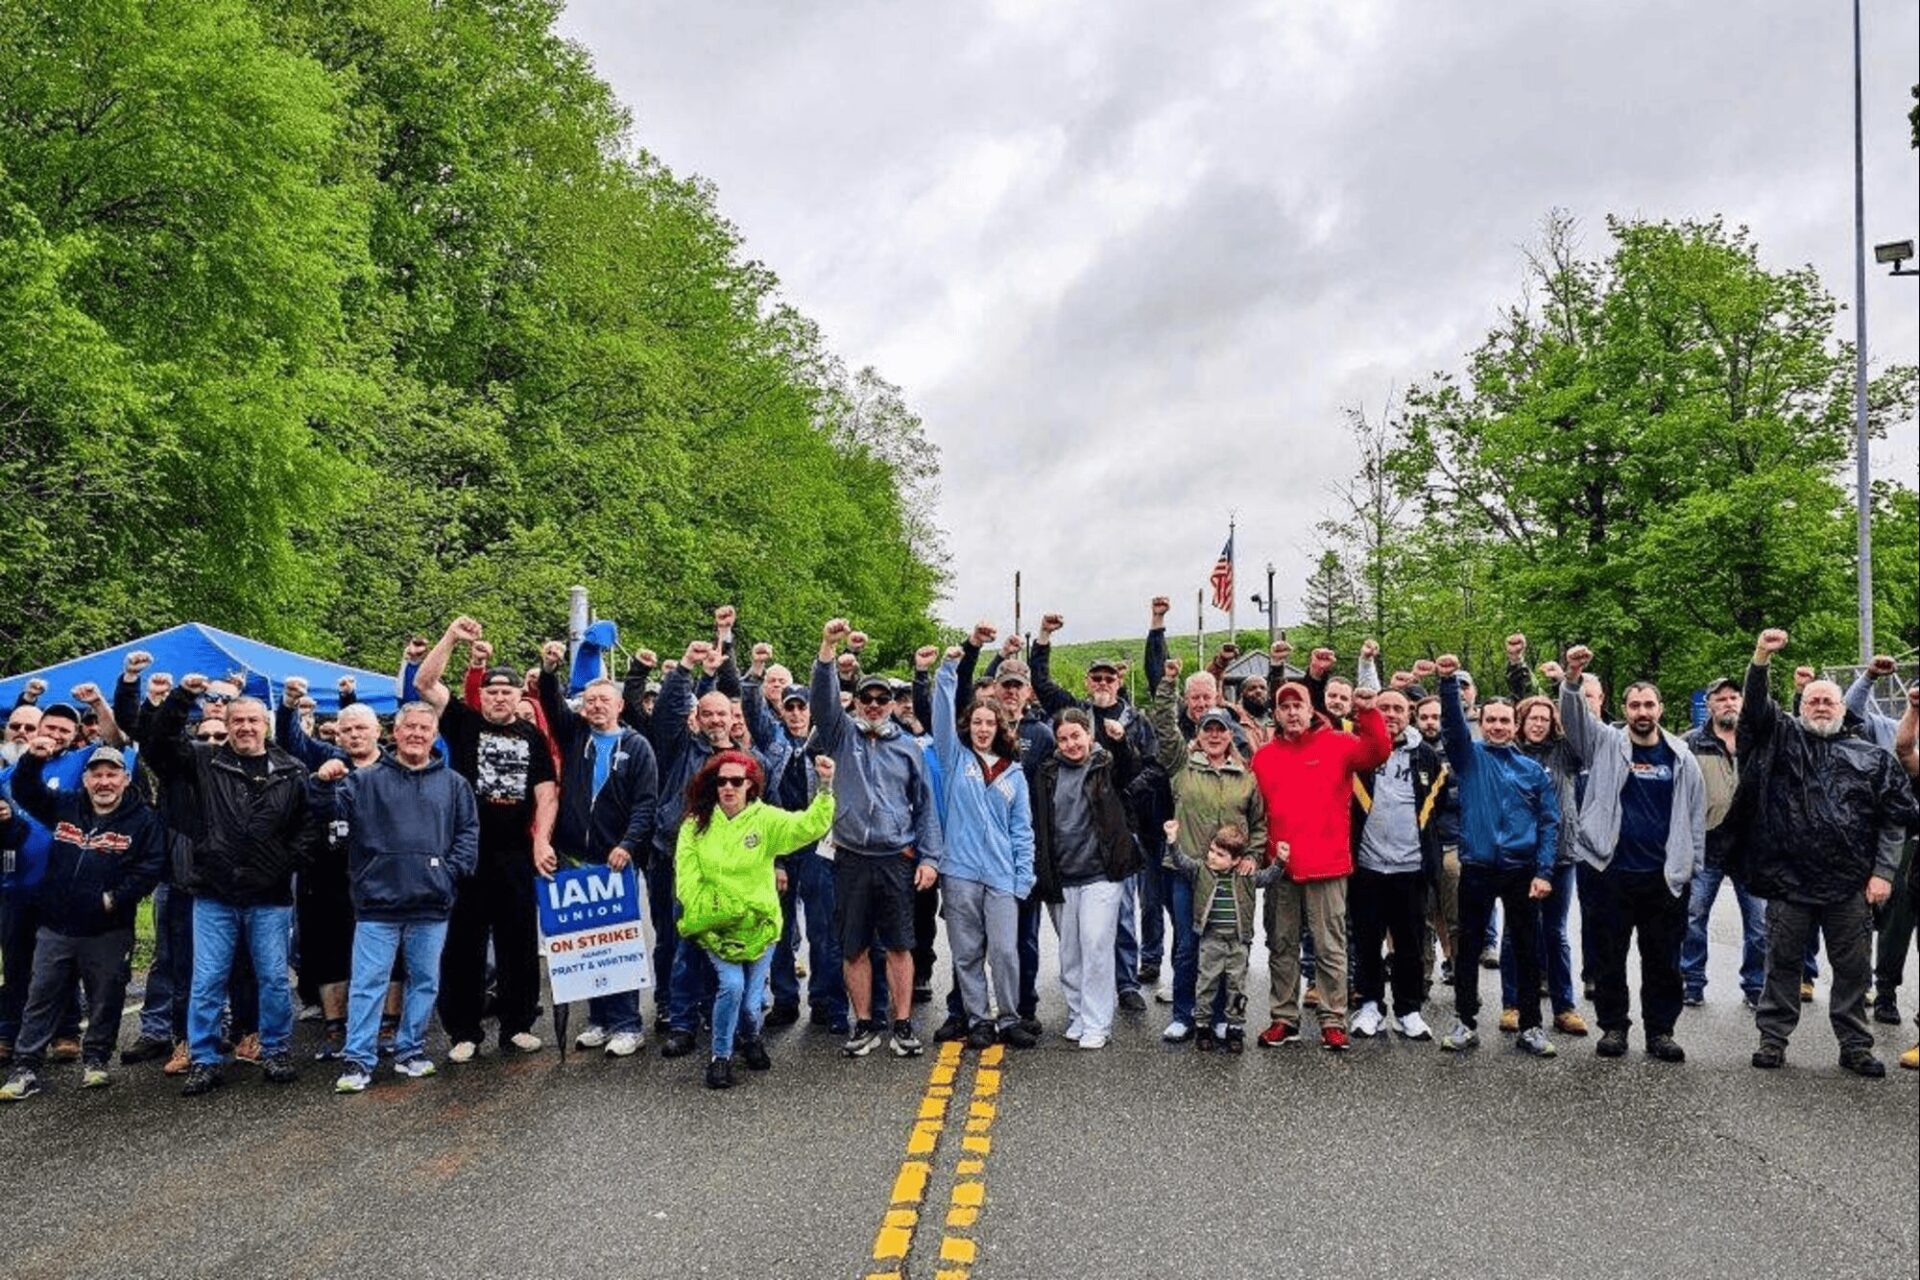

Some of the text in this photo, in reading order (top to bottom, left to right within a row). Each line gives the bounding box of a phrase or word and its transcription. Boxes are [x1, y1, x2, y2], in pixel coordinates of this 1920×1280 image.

[549, 872, 625, 910] IAM
[558, 903, 623, 923] UNION
[550, 927, 639, 953] ON STRIKE!
[551, 952, 644, 976] PRATT & WHITNEY
[581, 948, 612, 958] AGAINST
